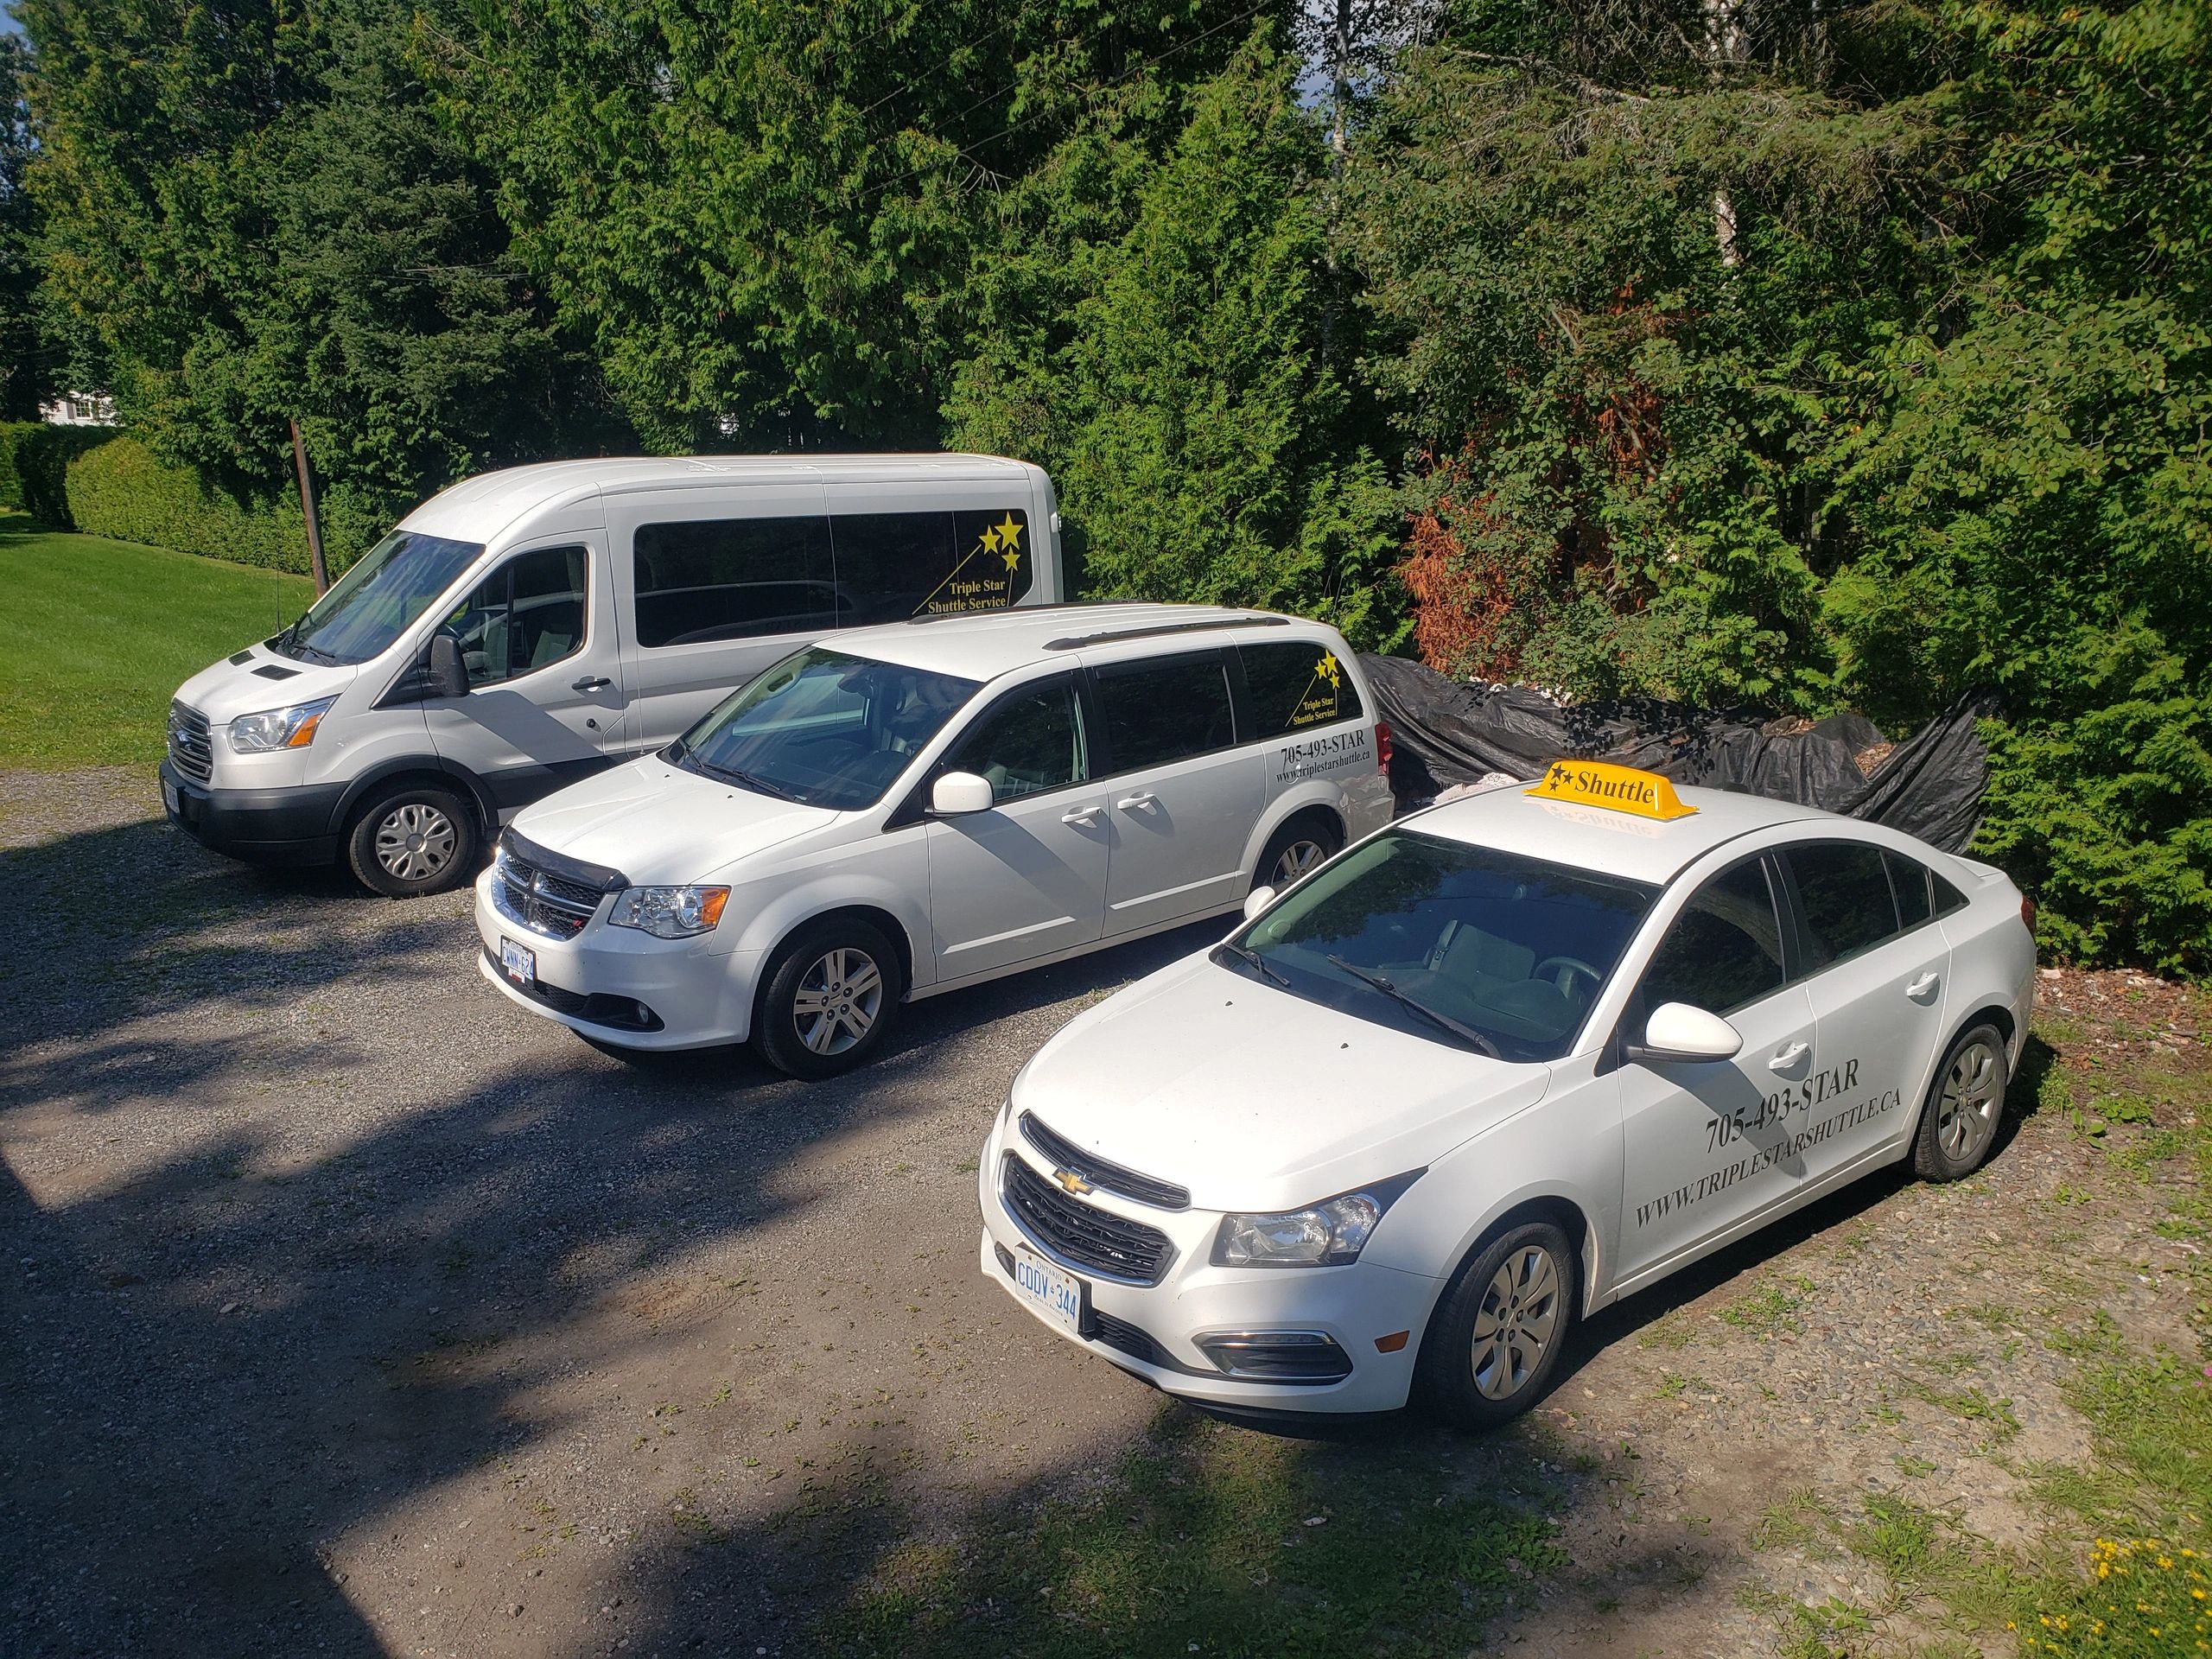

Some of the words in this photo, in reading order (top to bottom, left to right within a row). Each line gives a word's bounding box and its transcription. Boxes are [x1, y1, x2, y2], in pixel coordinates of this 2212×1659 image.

[949, 580, 982, 597] Triple
[983, 579, 1006, 592] Star
[928, 598, 967, 614] Shuttle
[969, 595, 1007, 610] Service
[1293, 712, 1314, 726] Shuttle
[1314, 709, 1336, 721] Service
[1302, 700, 1321, 711] Triple
[1321, 697, 1334, 708] Star
[1281, 729, 1365, 768] 705-493-STAR
[1275, 750, 1370, 783] www.triplestarshuttle.ca
[1574, 771, 1654, 804] Shuttle
[1705, 1058, 1859, 1154] 705-493-STAR
[1636, 1087, 1901, 1230] WWW.TRIPLESTARSHUTTLE.CA
[1036, 1260, 1063, 1281] ONTARIO
